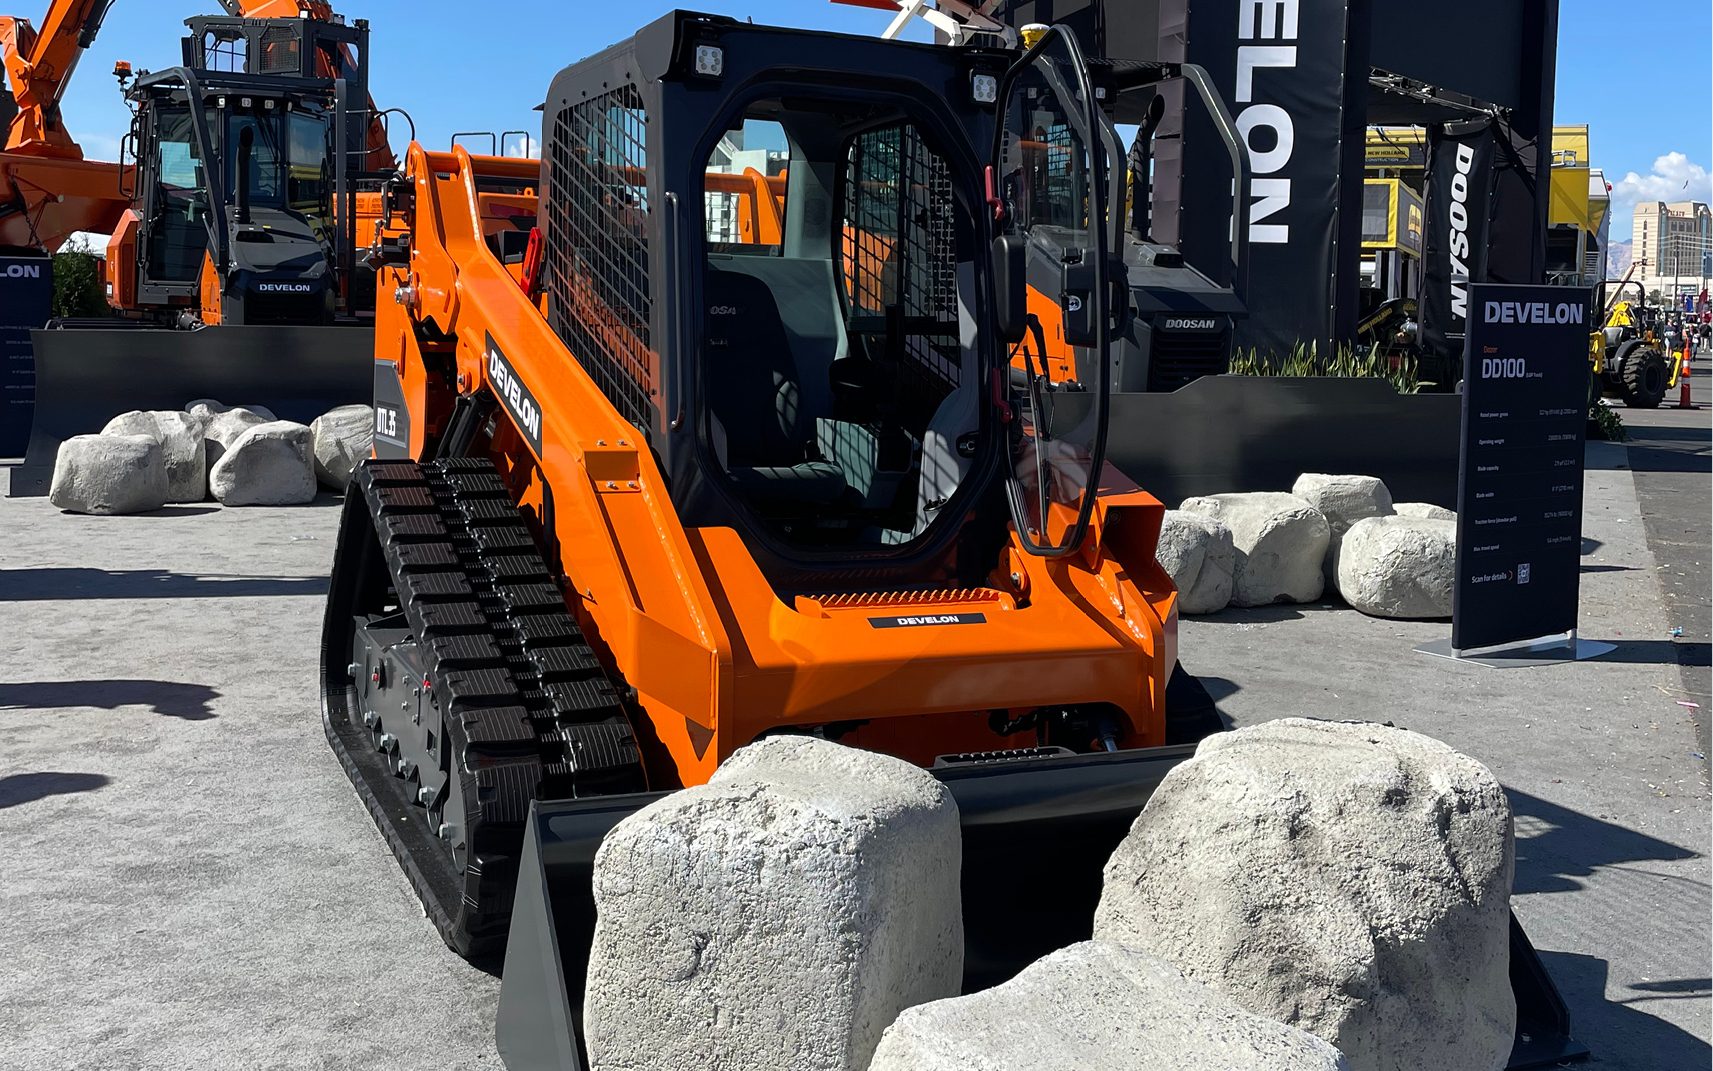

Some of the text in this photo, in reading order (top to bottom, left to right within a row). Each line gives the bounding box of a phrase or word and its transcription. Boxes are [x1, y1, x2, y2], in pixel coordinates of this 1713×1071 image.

[1449, 142, 1474, 318] DOOSAN
[1484, 301, 1583, 324] DEVELON
[1165, 320, 1216, 328] DOOSAN
[1482, 358, 1526, 378] DD100
[489, 349, 539, 441] DEVELON
[1471, 576, 1483, 584] Scan
[1491, 572, 1507, 581] details
[897, 615, 960, 625] DEVELON
